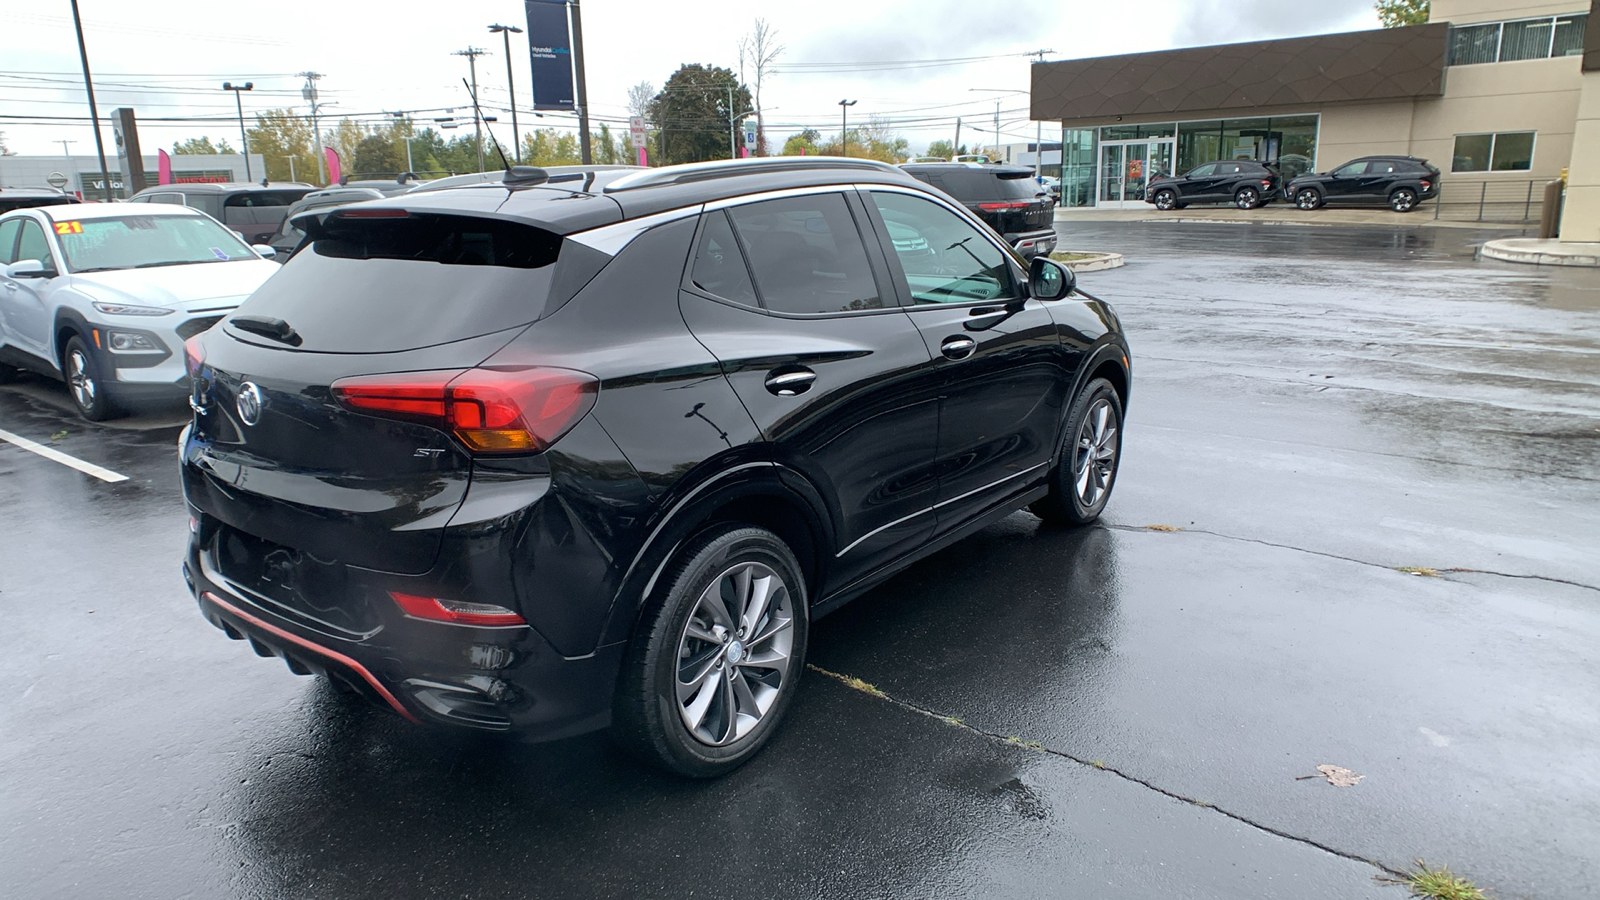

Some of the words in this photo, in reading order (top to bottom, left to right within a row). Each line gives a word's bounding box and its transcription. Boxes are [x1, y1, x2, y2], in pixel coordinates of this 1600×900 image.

[175, 176, 227, 184] NISSAN
[56, 221, 81, 234] 21
[413, 448, 446, 458] ST
